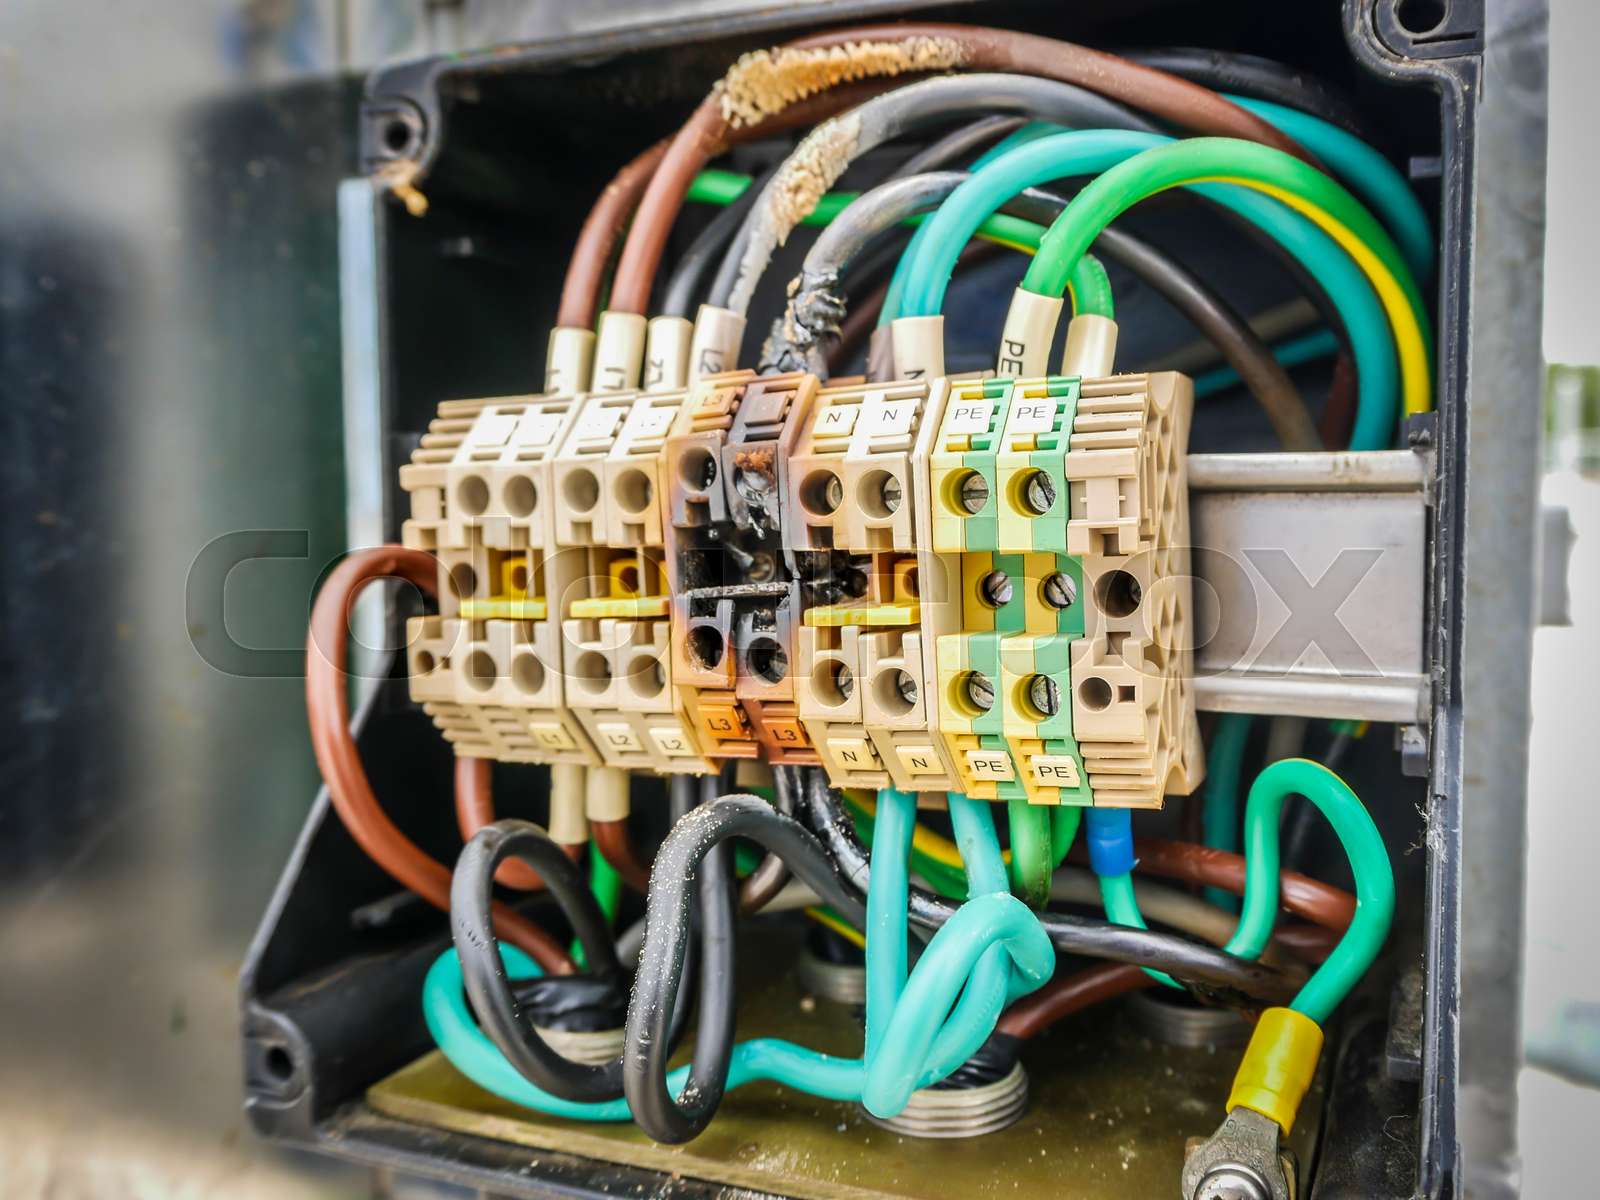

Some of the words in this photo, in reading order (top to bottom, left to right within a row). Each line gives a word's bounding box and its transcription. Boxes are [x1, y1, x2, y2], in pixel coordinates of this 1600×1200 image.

[1001, 339, 1025, 376] PE
[826, 411, 842, 424] N
[883, 408, 898, 421] N
[954, 406, 984, 420] PE
[1016, 405, 1048, 420] PE
[707, 717, 732, 732] L3
[541, 733, 561, 745] L1
[608, 734, 632, 746] L2
[774, 727, 798, 742] L3
[661, 738, 684, 751] L2
[842, 750, 858, 763] N
[911, 756, 928, 769] N
[974, 759, 1005, 773] PE
[1038, 765, 1070, 779] PE
